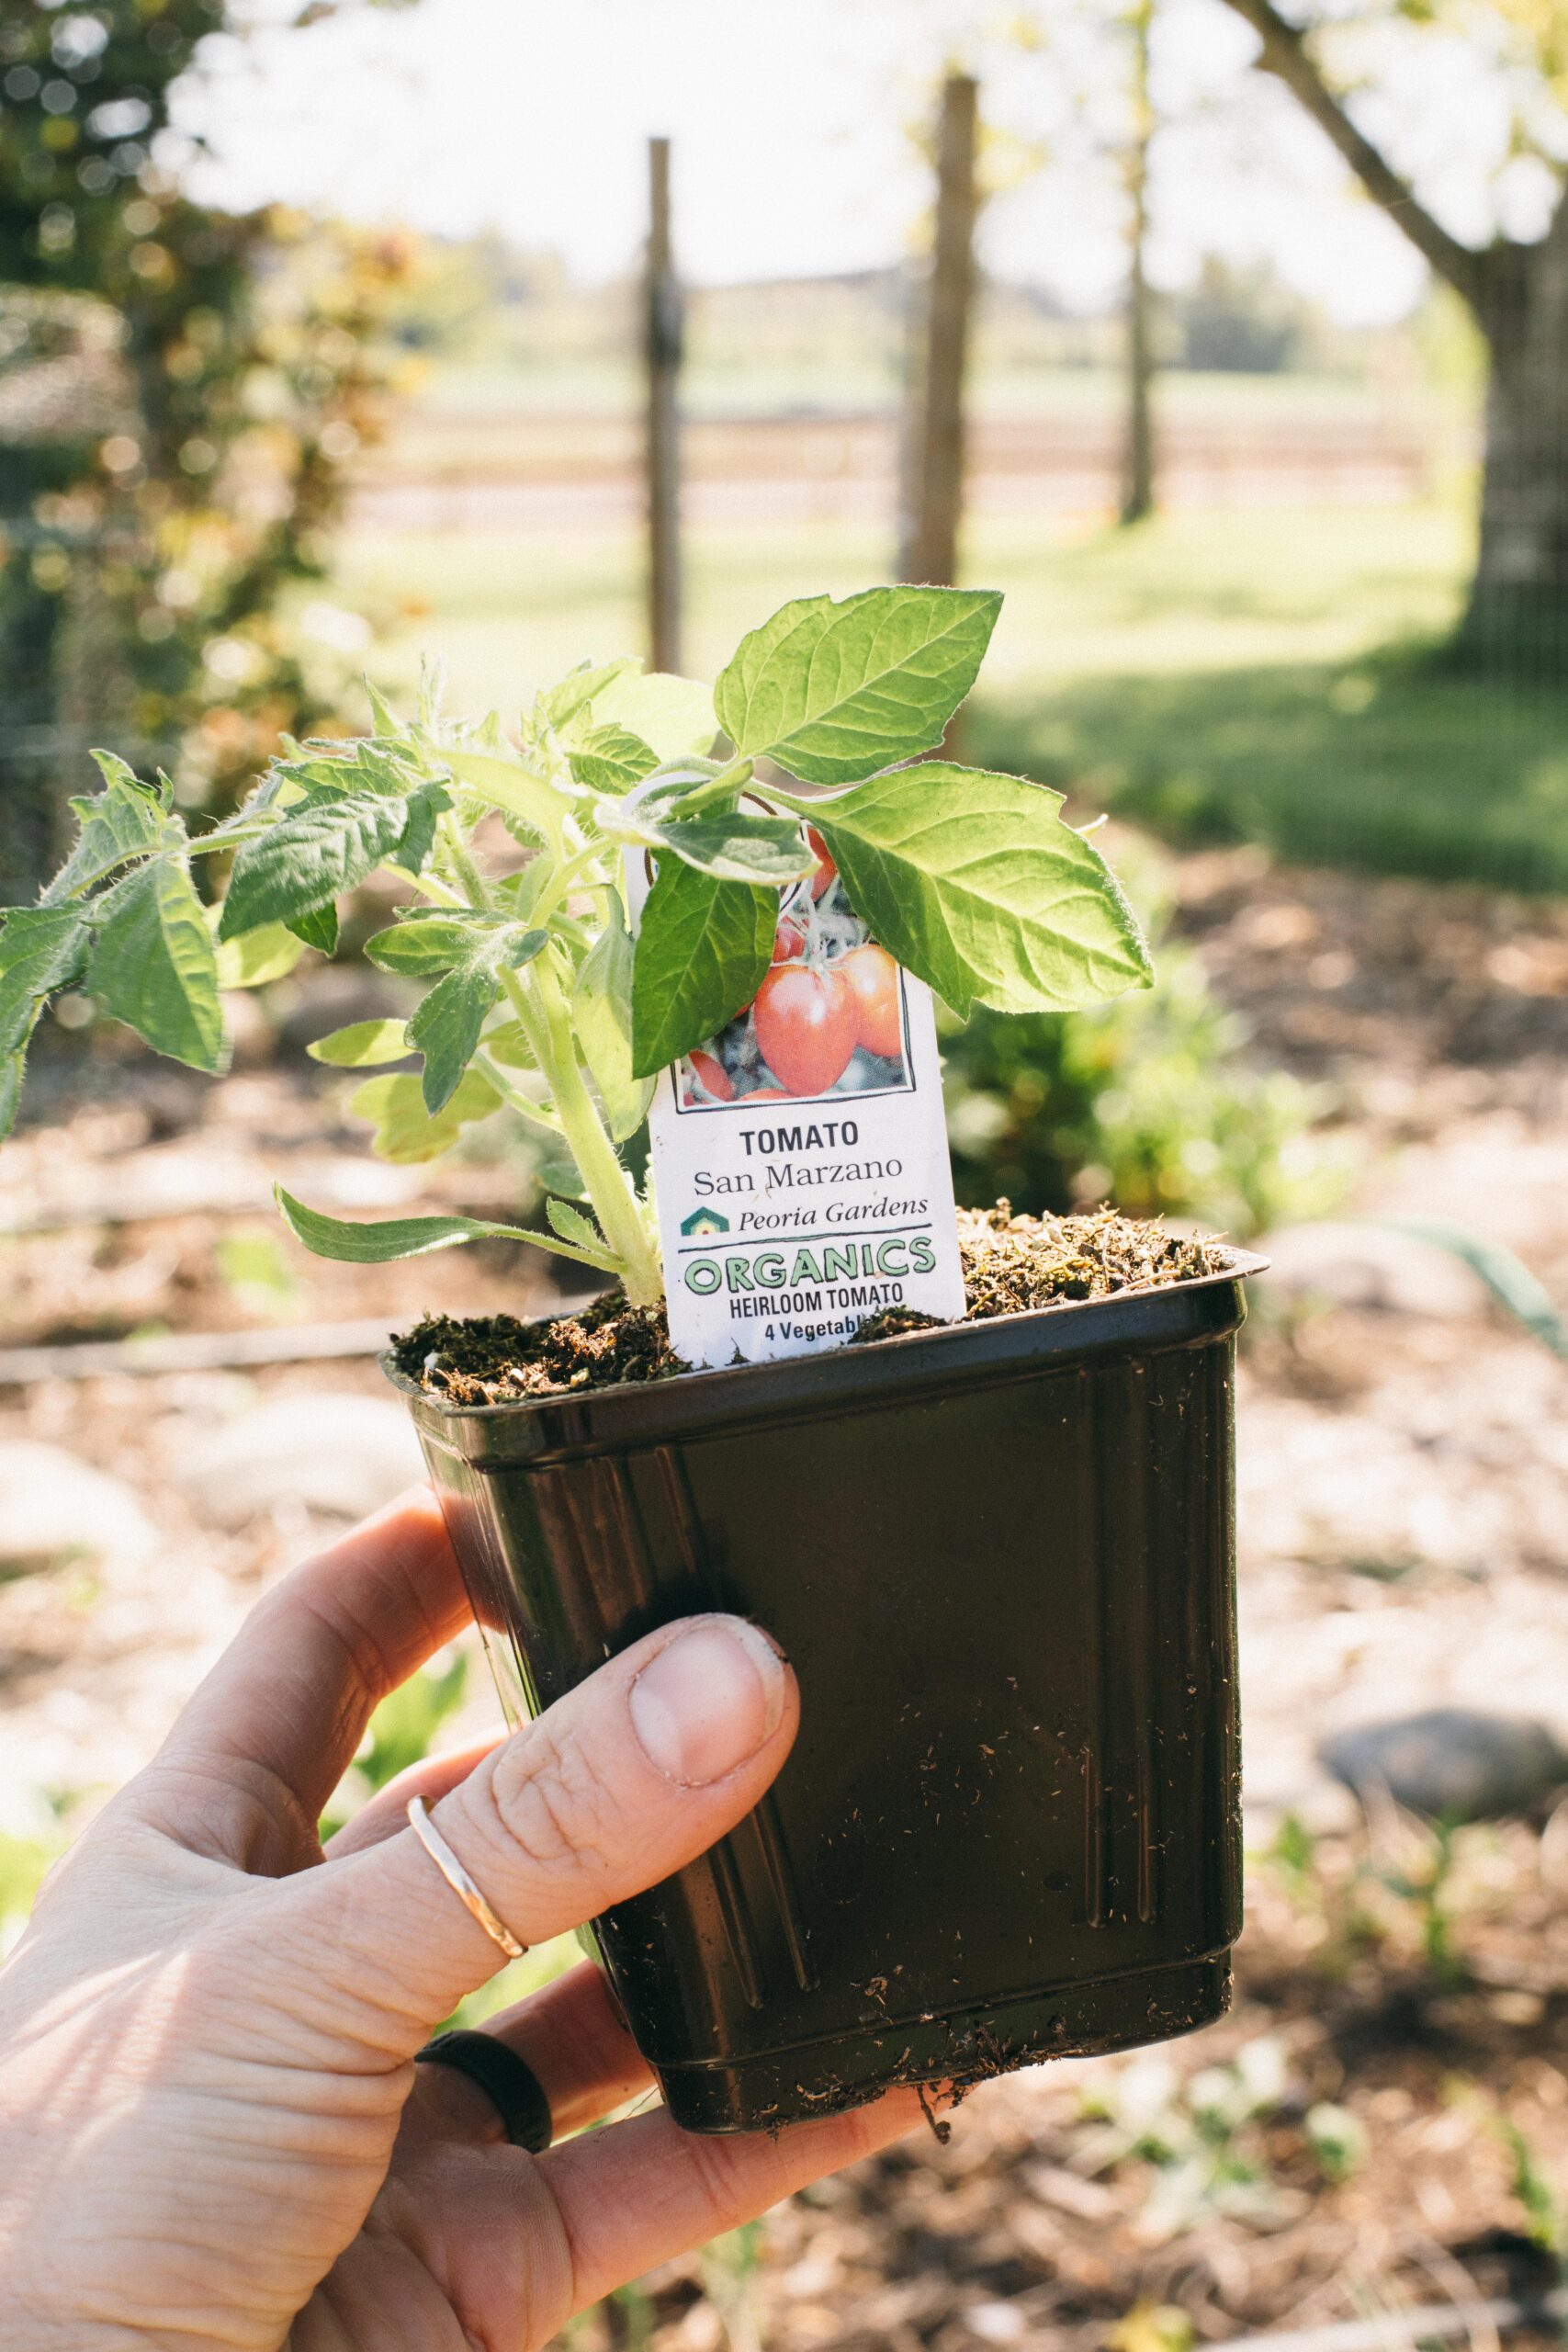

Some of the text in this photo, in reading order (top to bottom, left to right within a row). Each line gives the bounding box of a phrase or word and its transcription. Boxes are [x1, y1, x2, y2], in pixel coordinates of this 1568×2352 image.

[739, 1121, 859, 1156] TOMATO
[694, 1159, 903, 1196] San Marzano
[738, 1196, 929, 1232] Peoria Gardens
[683, 1237, 936, 1295] ORGANICS
[729, 1283, 904, 1318] HEIRLOOM TOMATO
[764, 1324, 774, 1340] 4
